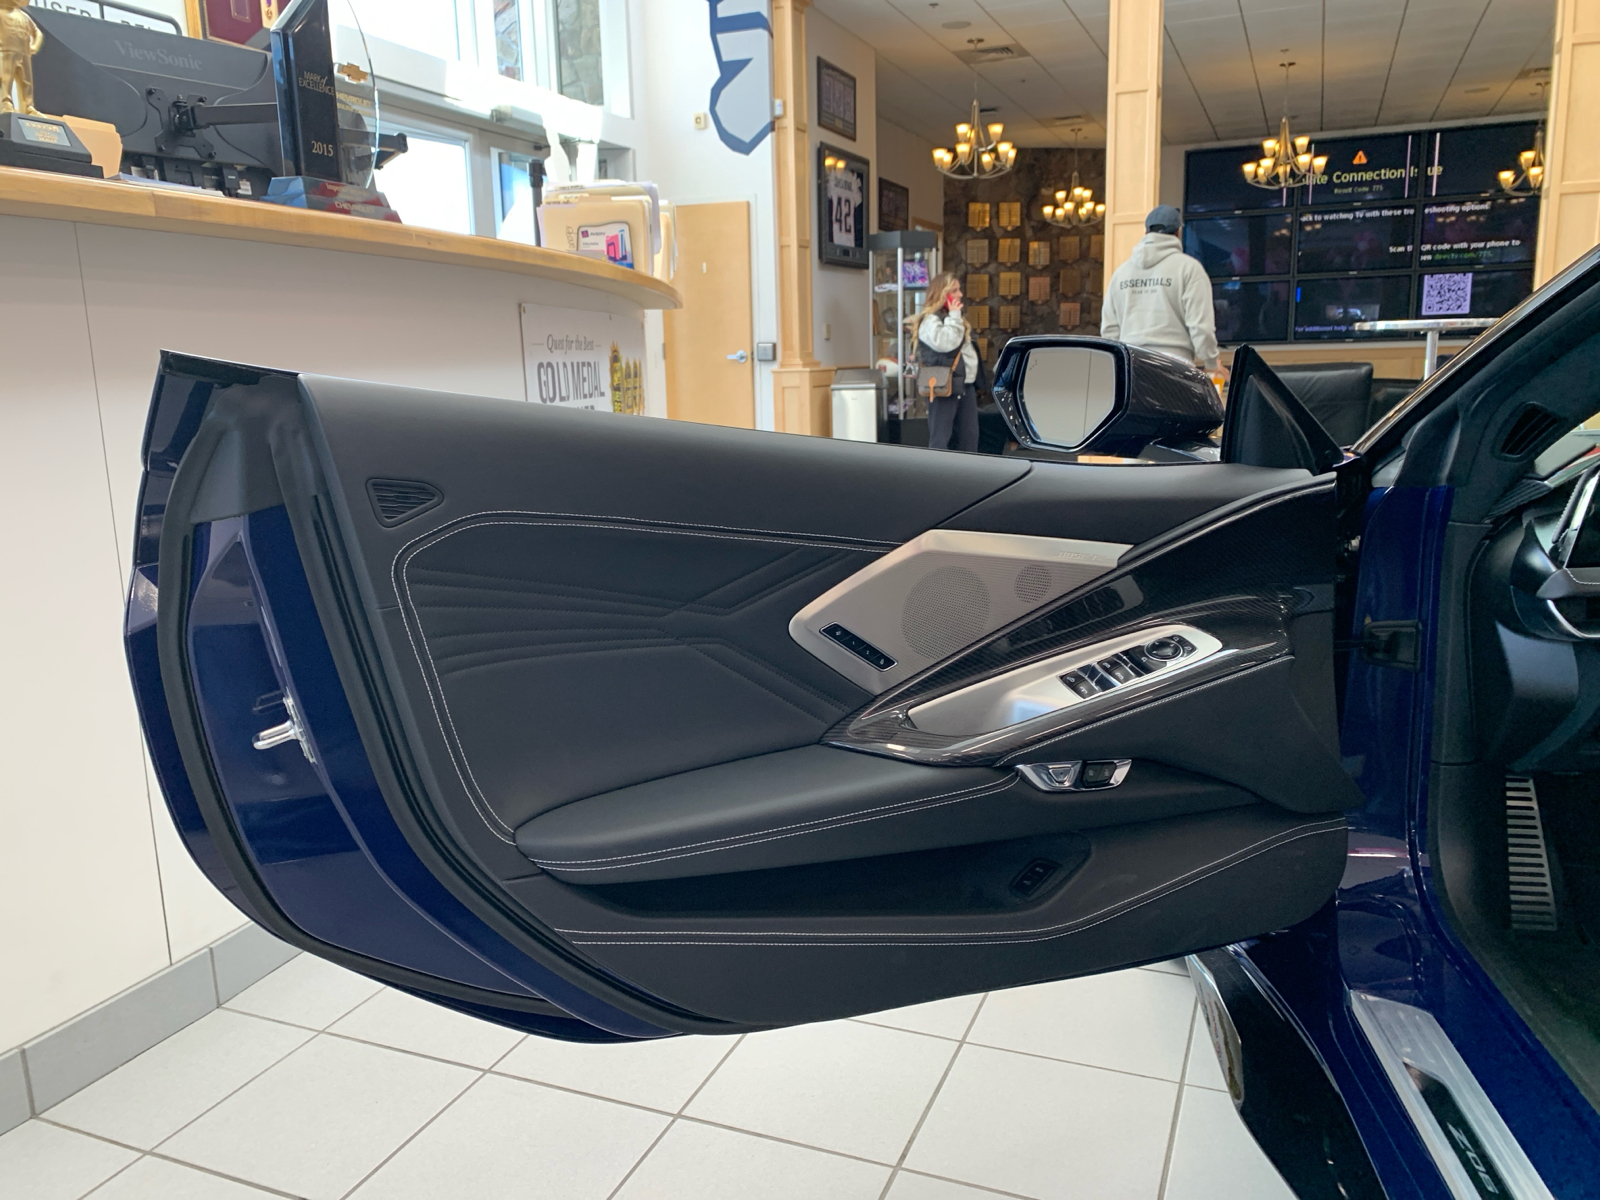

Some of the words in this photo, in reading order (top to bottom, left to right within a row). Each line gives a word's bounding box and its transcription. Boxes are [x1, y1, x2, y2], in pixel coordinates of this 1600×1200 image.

[113, 39, 203, 71] ViewSonic
[303, 71, 321, 81] MARK
[298, 77, 335, 95] EXCELLENCE
[336, 91, 371, 108] HEVROLET
[311, 140, 334, 157] 2015
[1333, 167, 1405, 184] Connection
[835, 195, 852, 233] 42
[1323, 213, 1353, 221] watching
[1365, 210, 1380, 218] with
[1382, 209, 1402, 217] these
[1389, 245, 1405, 253] Scan
[1421, 243, 1432, 251] QR
[1433, 242, 1451, 250] code
[1453, 241, 1468, 249] with
[1486, 239, 1510, 248] phone
[1119, 277, 1172, 290] ESSENTIALS
[546, 333, 564, 353] Quest
[565, 334, 574, 355] for
[575, 334, 583, 351] the
[583, 336, 595, 351] Best
[536, 361, 570, 404] GOLD
[570, 360, 606, 401] MEDAL
[1446, 1122, 1499, 1195] Z06
